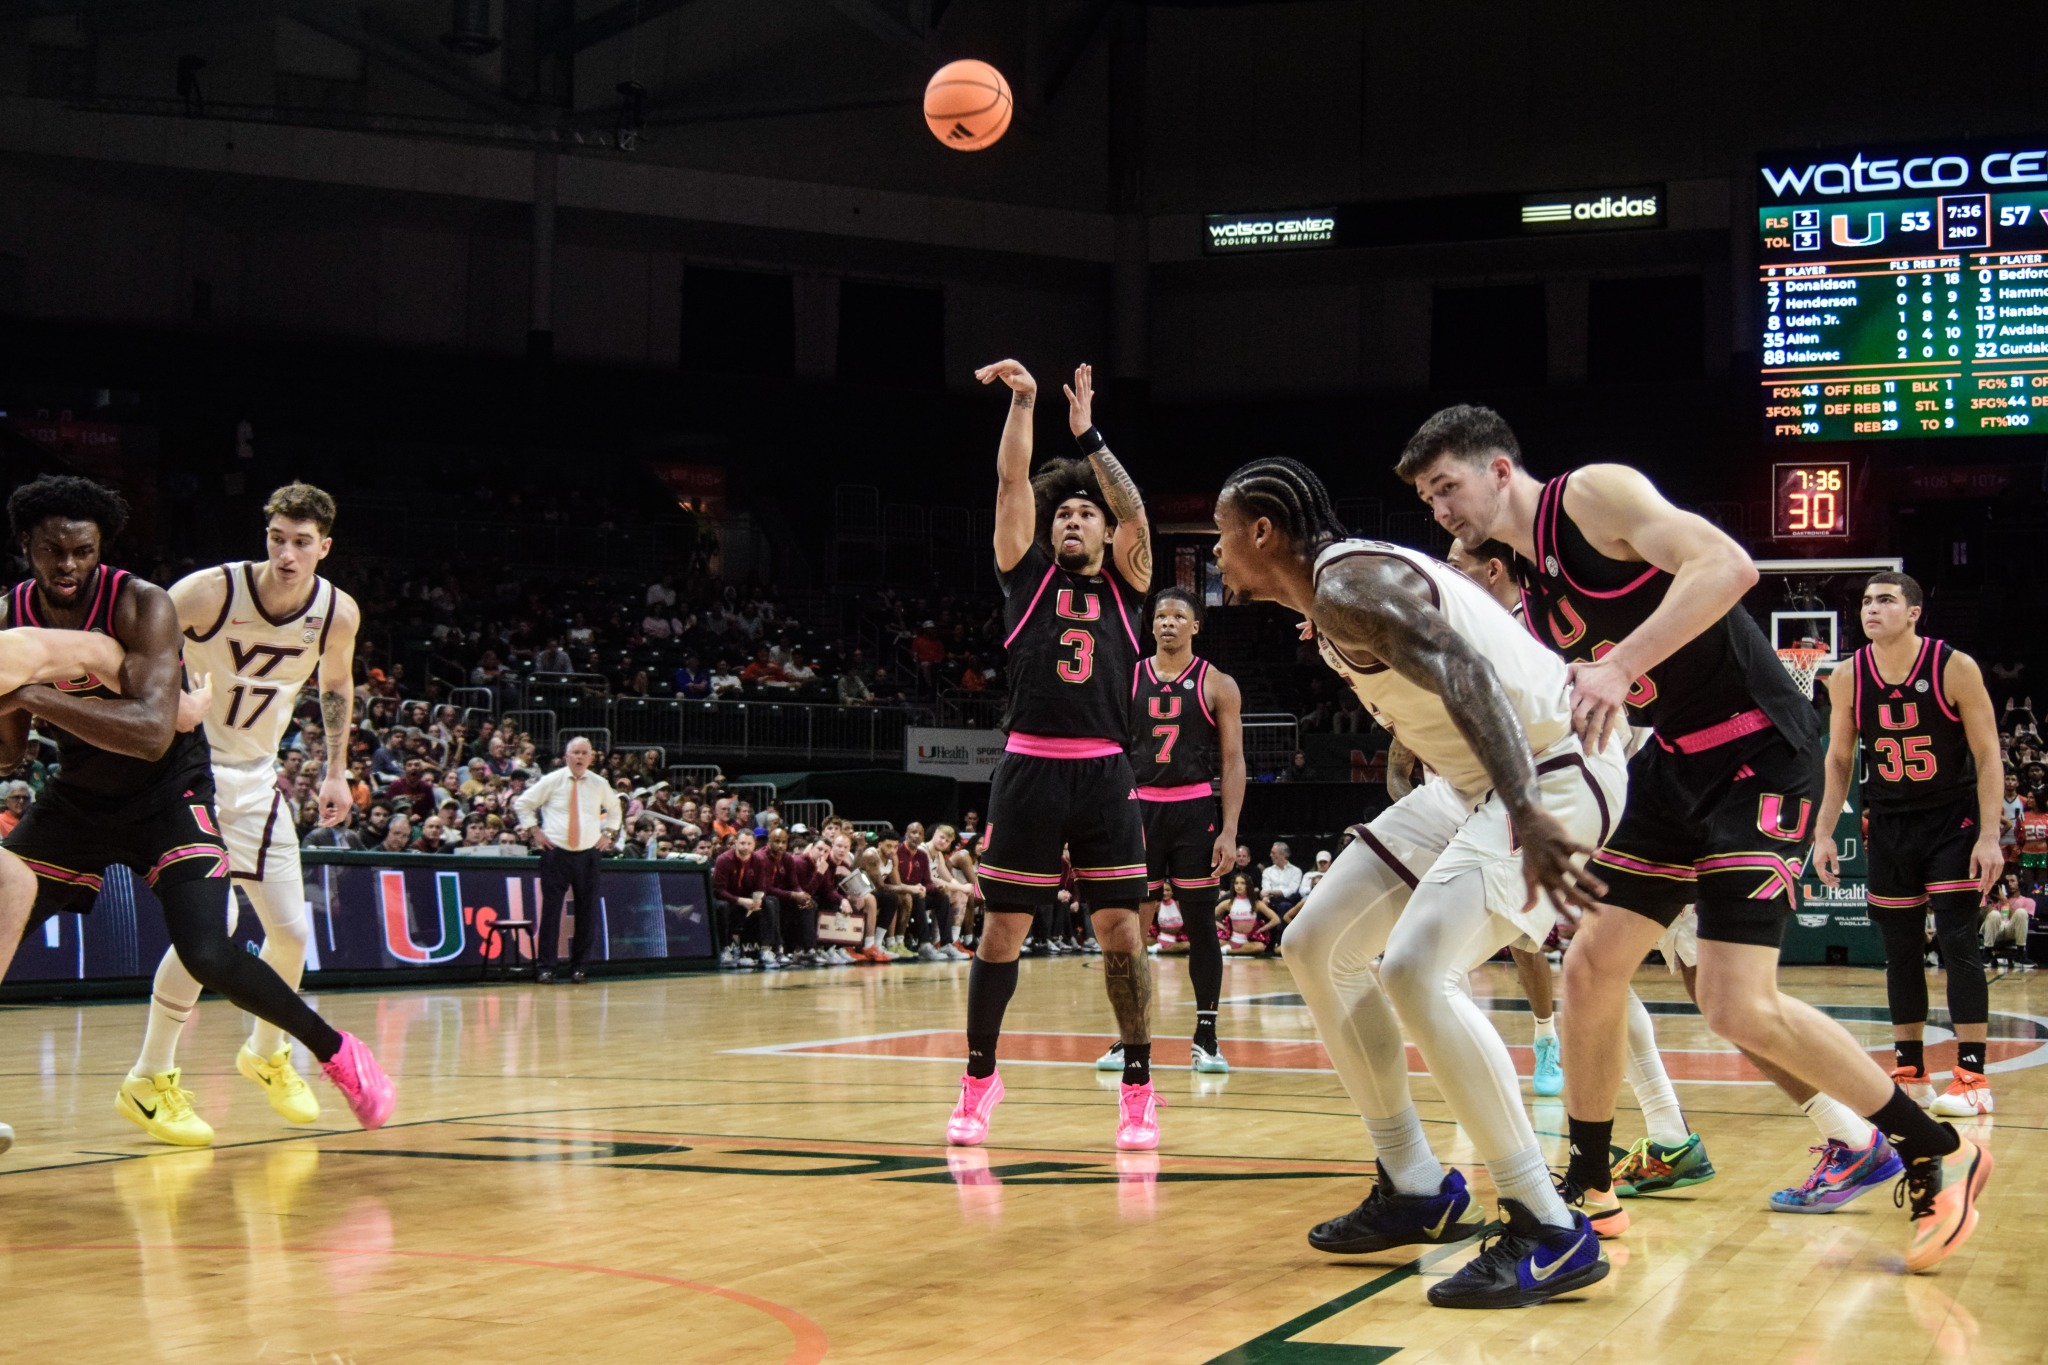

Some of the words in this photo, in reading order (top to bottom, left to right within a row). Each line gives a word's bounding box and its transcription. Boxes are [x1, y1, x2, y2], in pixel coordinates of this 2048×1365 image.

[1574, 196, 1656, 219] adidas
[1947, 205, 1981, 218] 7:36
[1999, 205, 2031, 226] 57
[1765, 217, 1789, 229] FLS
[1800, 212, 1812, 225] 2
[1900, 211, 1930, 232] 53
[1214, 236, 1257, 246] COOLING
[1262, 235, 1278, 243] THE
[1282, 232, 1331, 242] AMERICAS
[1764, 237, 1791, 248] TOL
[1801, 233, 1812, 246] 3
[1948, 226, 1977, 238] 2ND
[1785, 266, 1826, 276] PLAYER
[1890, 261, 1909, 270] FLS
[1913, 260, 1935, 269] REB
[1940, 258, 1960, 268] PTS
[2000, 254, 2042, 265] PLAYER
[1767, 282, 1779, 296] 3
[1785, 279, 1856, 292] Donaldson
[1896, 275, 1907, 287] 0
[1922, 274, 1932, 286] 2
[1944, 272, 1960, 284] 18
[1978, 269, 1992, 284] 0
[1767, 297, 1780, 312] 7
[1785, 296, 1857, 309] Henderson
[1896, 293, 1908, 305] 0
[1922, 291, 1932, 304] 6
[1947, 290, 1957, 302] 9
[1979, 287, 1992, 303] 3
[1767, 315, 1780, 330] 8
[1786, 314, 1821, 327] Udeh
[1823, 314, 1840, 325] Jr.
[1899, 311, 1906, 323] 1
[1922, 310, 1932, 322] 8
[1947, 308, 1958, 320] 4
[1975, 305, 1996, 321] 13
[1763, 332, 1785, 348] 35
[1786, 333, 1820, 345] Allen
[1897, 329, 1908, 341] 0
[1921, 327, 1933, 340] 4
[1945, 326, 1961, 338] 10
[1975, 323, 1997, 340] 17
[1763, 349, 1786, 365] 88
[1786, 350, 1841, 362] Malovec
[1897, 347, 1908, 359] 2
[1922, 345, 1933, 358] 0
[1948, 345, 1959, 357] 0
[1974, 342, 1998, 358] 32
[1773, 387, 1801, 399] FG%
[1801, 385, 1819, 397] 43
[1824, 385, 1851, 397] OFF
[1853, 384, 1881, 395] REB
[1884, 382, 1896, 393] 11
[1912, 381, 1939, 393] BLK
[1946, 379, 1953, 391] 1
[1978, 378, 2008, 390] FG%
[2010, 376, 2024, 388] 51
[1765, 405, 1802, 418] 3FG%
[1803, 403, 1817, 415] 17
[1824, 404, 1851, 415] DEF
[1854, 402, 1882, 414] REB
[1883, 400, 1897, 412] 18
[1915, 400, 1939, 412] STL
[1944, 398, 1954, 410] 5
[1970, 397, 2008, 409] 3FG%
[2007, 395, 2027, 407] 44
[1775, 424, 1802, 436] FT%
[1801, 422, 1819, 435] 70
[1854, 421, 1881, 433] REB
[1881, 420, 1898, 431] 29
[1920, 419, 1940, 430] TO
[1944, 417, 1954, 429] 9
[1980, 416, 2008, 428] FT%
[2005, 414, 2029, 426] 100
[1796, 470, 1841, 491] 7:36
[1788, 493, 1834, 530] 30
[226, 637, 308, 678] VT
[1057, 628, 1095, 684] 3
[223, 683, 280, 730] 17
[1153, 725, 1179, 763] 7
[1874, 736, 1937, 782] 35
